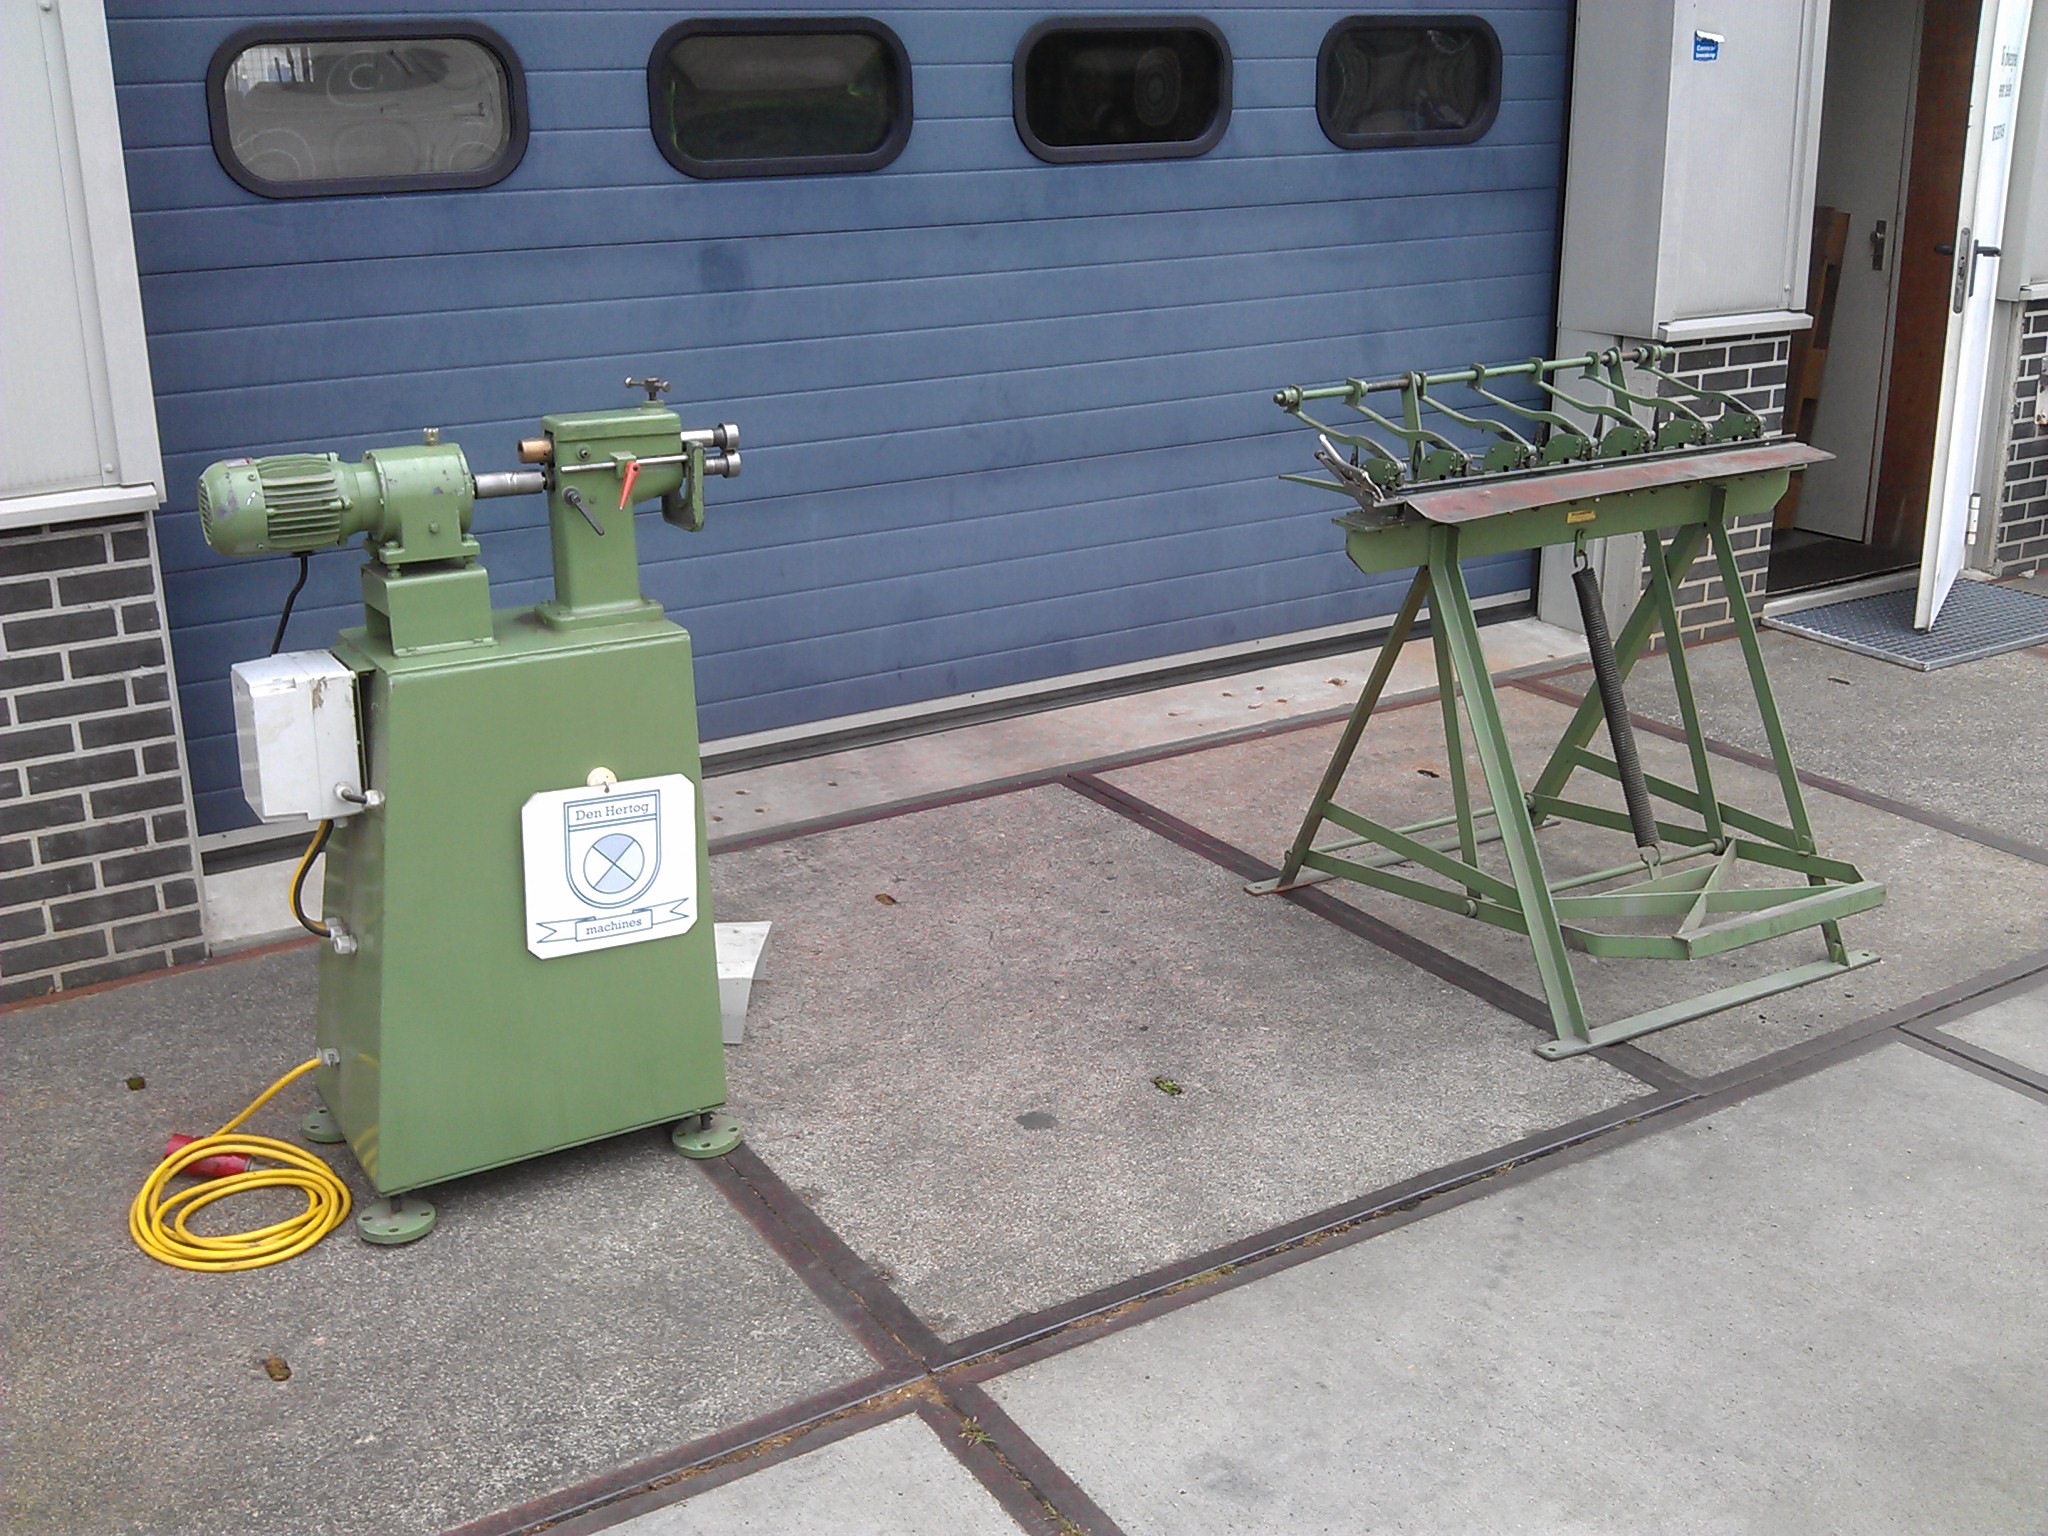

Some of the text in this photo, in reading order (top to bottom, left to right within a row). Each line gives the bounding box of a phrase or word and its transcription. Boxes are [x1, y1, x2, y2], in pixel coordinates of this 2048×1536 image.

[576, 803, 649, 821] Den Hertog
[586, 919, 642, 935] machines
